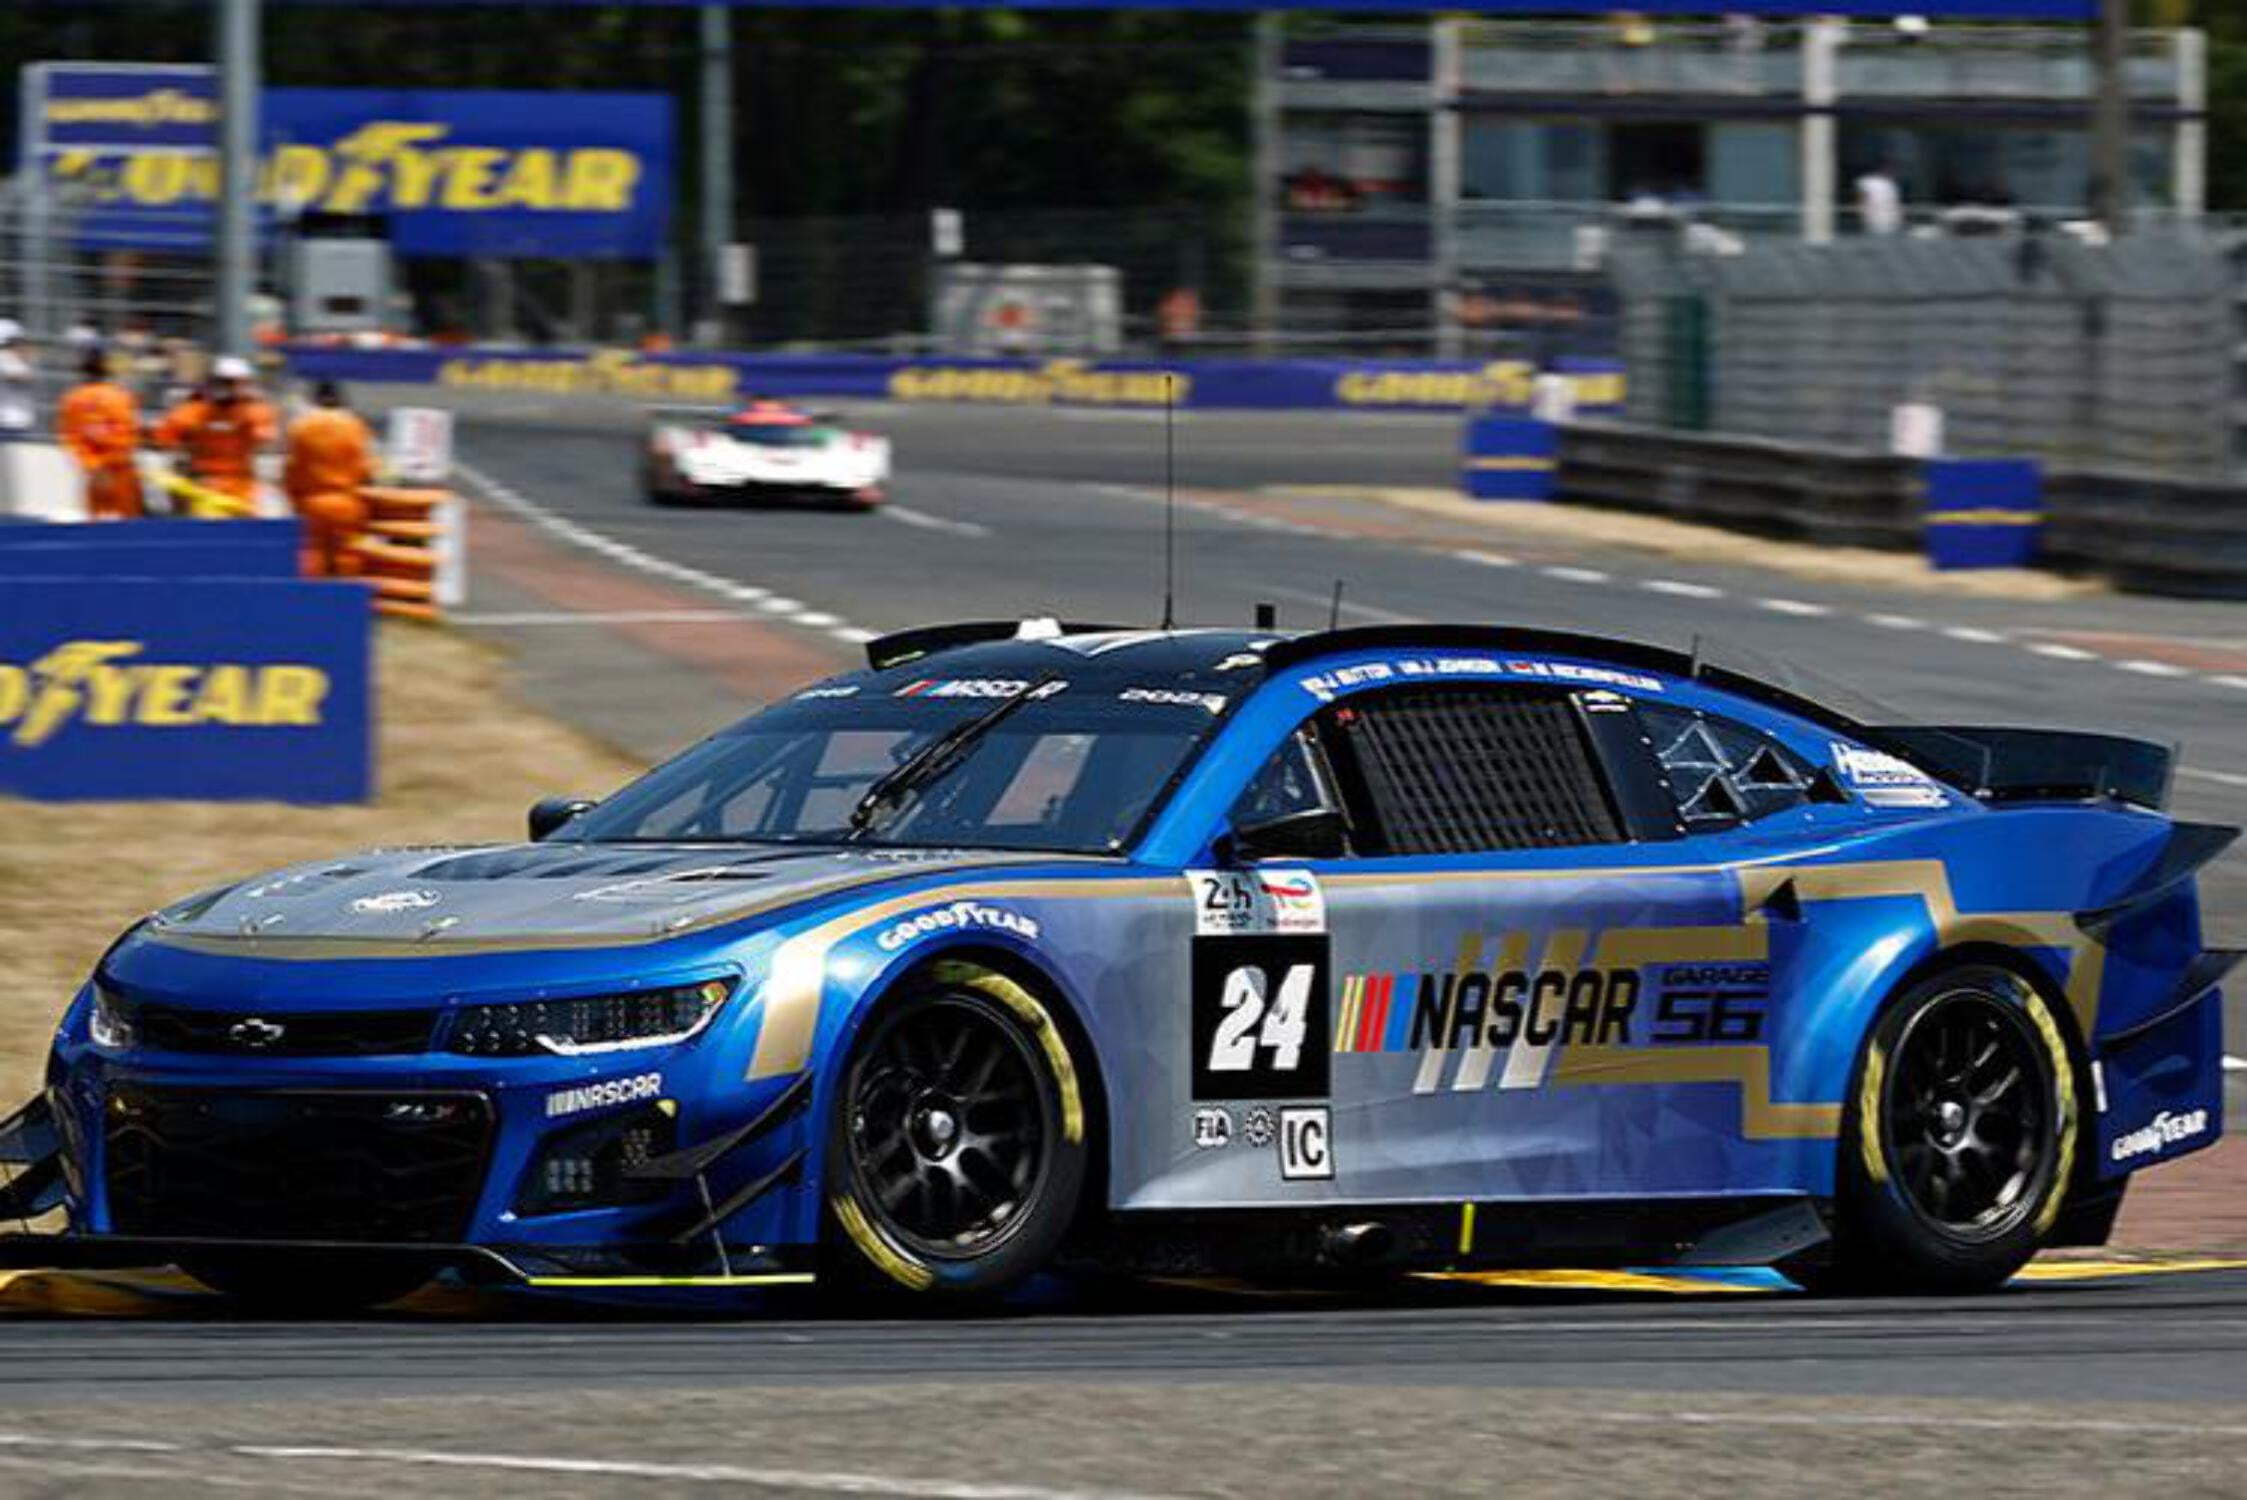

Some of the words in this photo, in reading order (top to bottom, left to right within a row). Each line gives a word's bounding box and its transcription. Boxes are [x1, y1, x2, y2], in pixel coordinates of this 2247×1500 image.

[876, 901, 1039, 951] GOODYEAR
[1662, 967, 1770, 985] GARAGE
[1207, 964, 1316, 1072] 24
[1409, 968, 1641, 1051] NASCAR
[1650, 990, 1770, 1042] 56
[573, 1072, 662, 1111] NASCAR
[1195, 1115, 1231, 1139] FIA
[1287, 1119, 1325, 1167] IC
